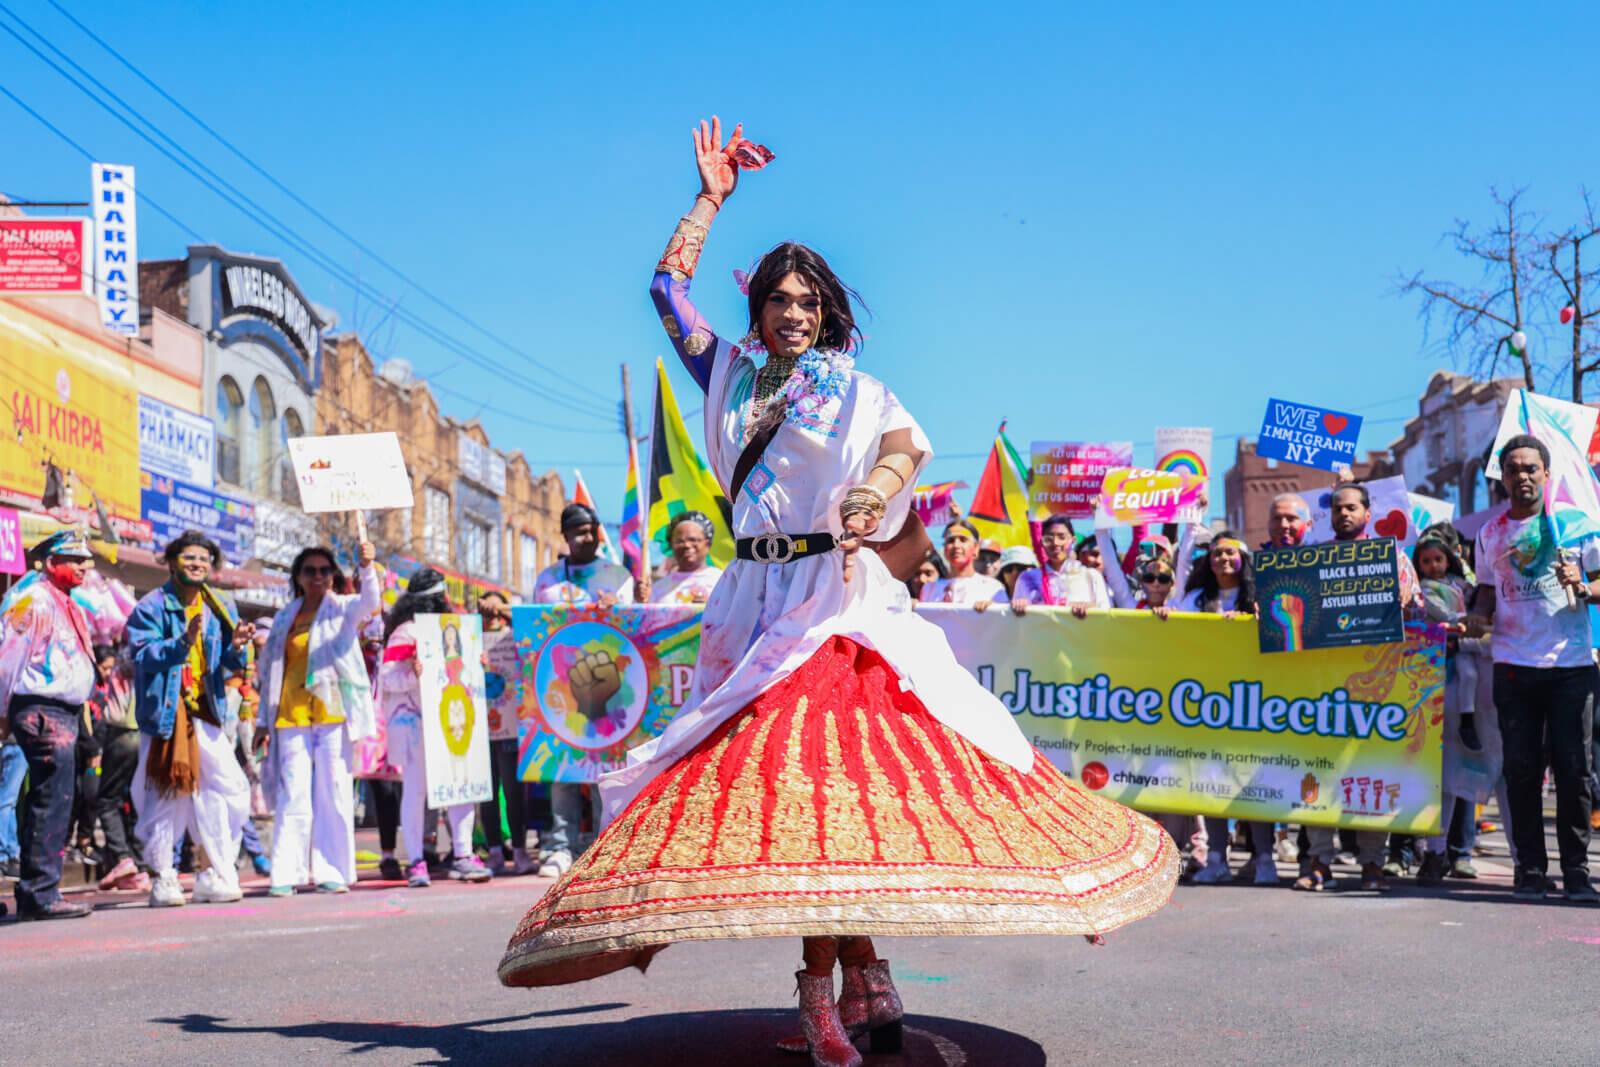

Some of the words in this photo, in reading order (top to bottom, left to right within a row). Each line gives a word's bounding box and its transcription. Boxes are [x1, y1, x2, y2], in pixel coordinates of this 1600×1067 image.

[28, 229, 76, 243] KIRPA
[102, 169, 128, 321] PHARMACY
[12, 390, 41, 435] SAI
[48, 402, 105, 456] KIRPA
[1275, 403, 1320, 432] WE
[139, 411, 210, 465] PHARMACY
[1263, 424, 1355, 454] IMMIGRANT
[1284, 442, 1320, 465] NY
[1034, 464, 1052, 475] LET
[1054, 464, 1068, 475] US
[1070, 464, 1084, 475] BE
[1113, 487, 1184, 511] EQUITY
[1256, 539, 1394, 572] PROTECT
[1319, 566, 1346, 580] BLACK
[1348, 566, 1355, 577] &
[1357, 562, 1392, 575] BROWN
[1322, 594, 1356, 609] ASYLUM
[1357, 591, 1394, 605] SEEKERS
[669, 664, 696, 707] P
[1000, 668, 1163, 725] Justice
[1168, 678, 1408, 741] Collective
[1033, 736, 1080, 752] Equality
[1085, 740, 1151, 757] Project-led
[1155, 745, 1207, 760] initiative
[1211, 749, 1222, 761] in
[1226, 752, 1300, 770] partnership
[1305, 757, 1335, 769] with:
[1113, 770, 1159, 787] chhaya
[1161, 775, 1183, 787] CDC
[1242, 785, 1284, 799] SISTERS
